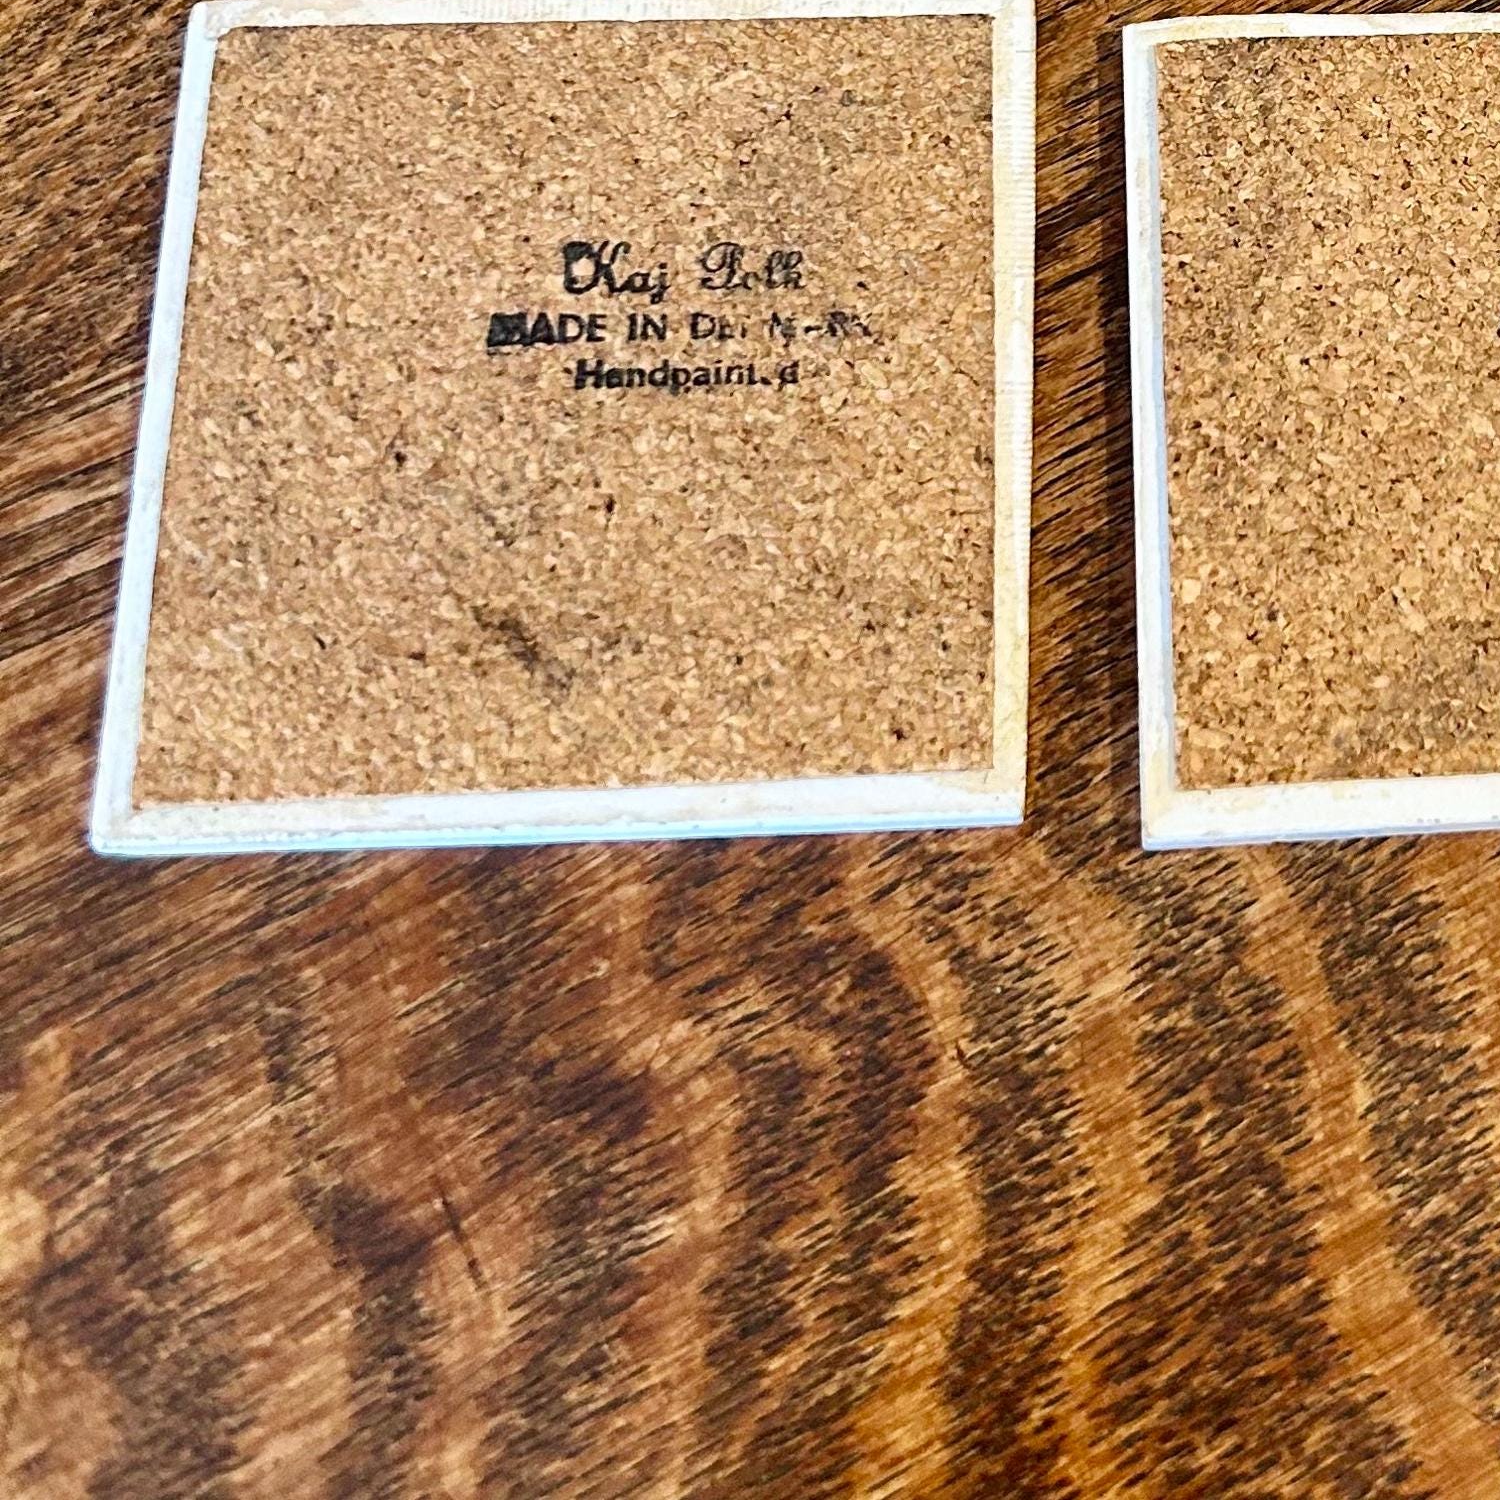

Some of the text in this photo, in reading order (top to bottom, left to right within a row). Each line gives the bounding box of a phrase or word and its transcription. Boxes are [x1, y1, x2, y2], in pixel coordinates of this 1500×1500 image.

[562, 241, 805, 304] Kaj Polk
[627, 313, 668, 341] IN
[574, 358, 800, 391] Handpaintd
